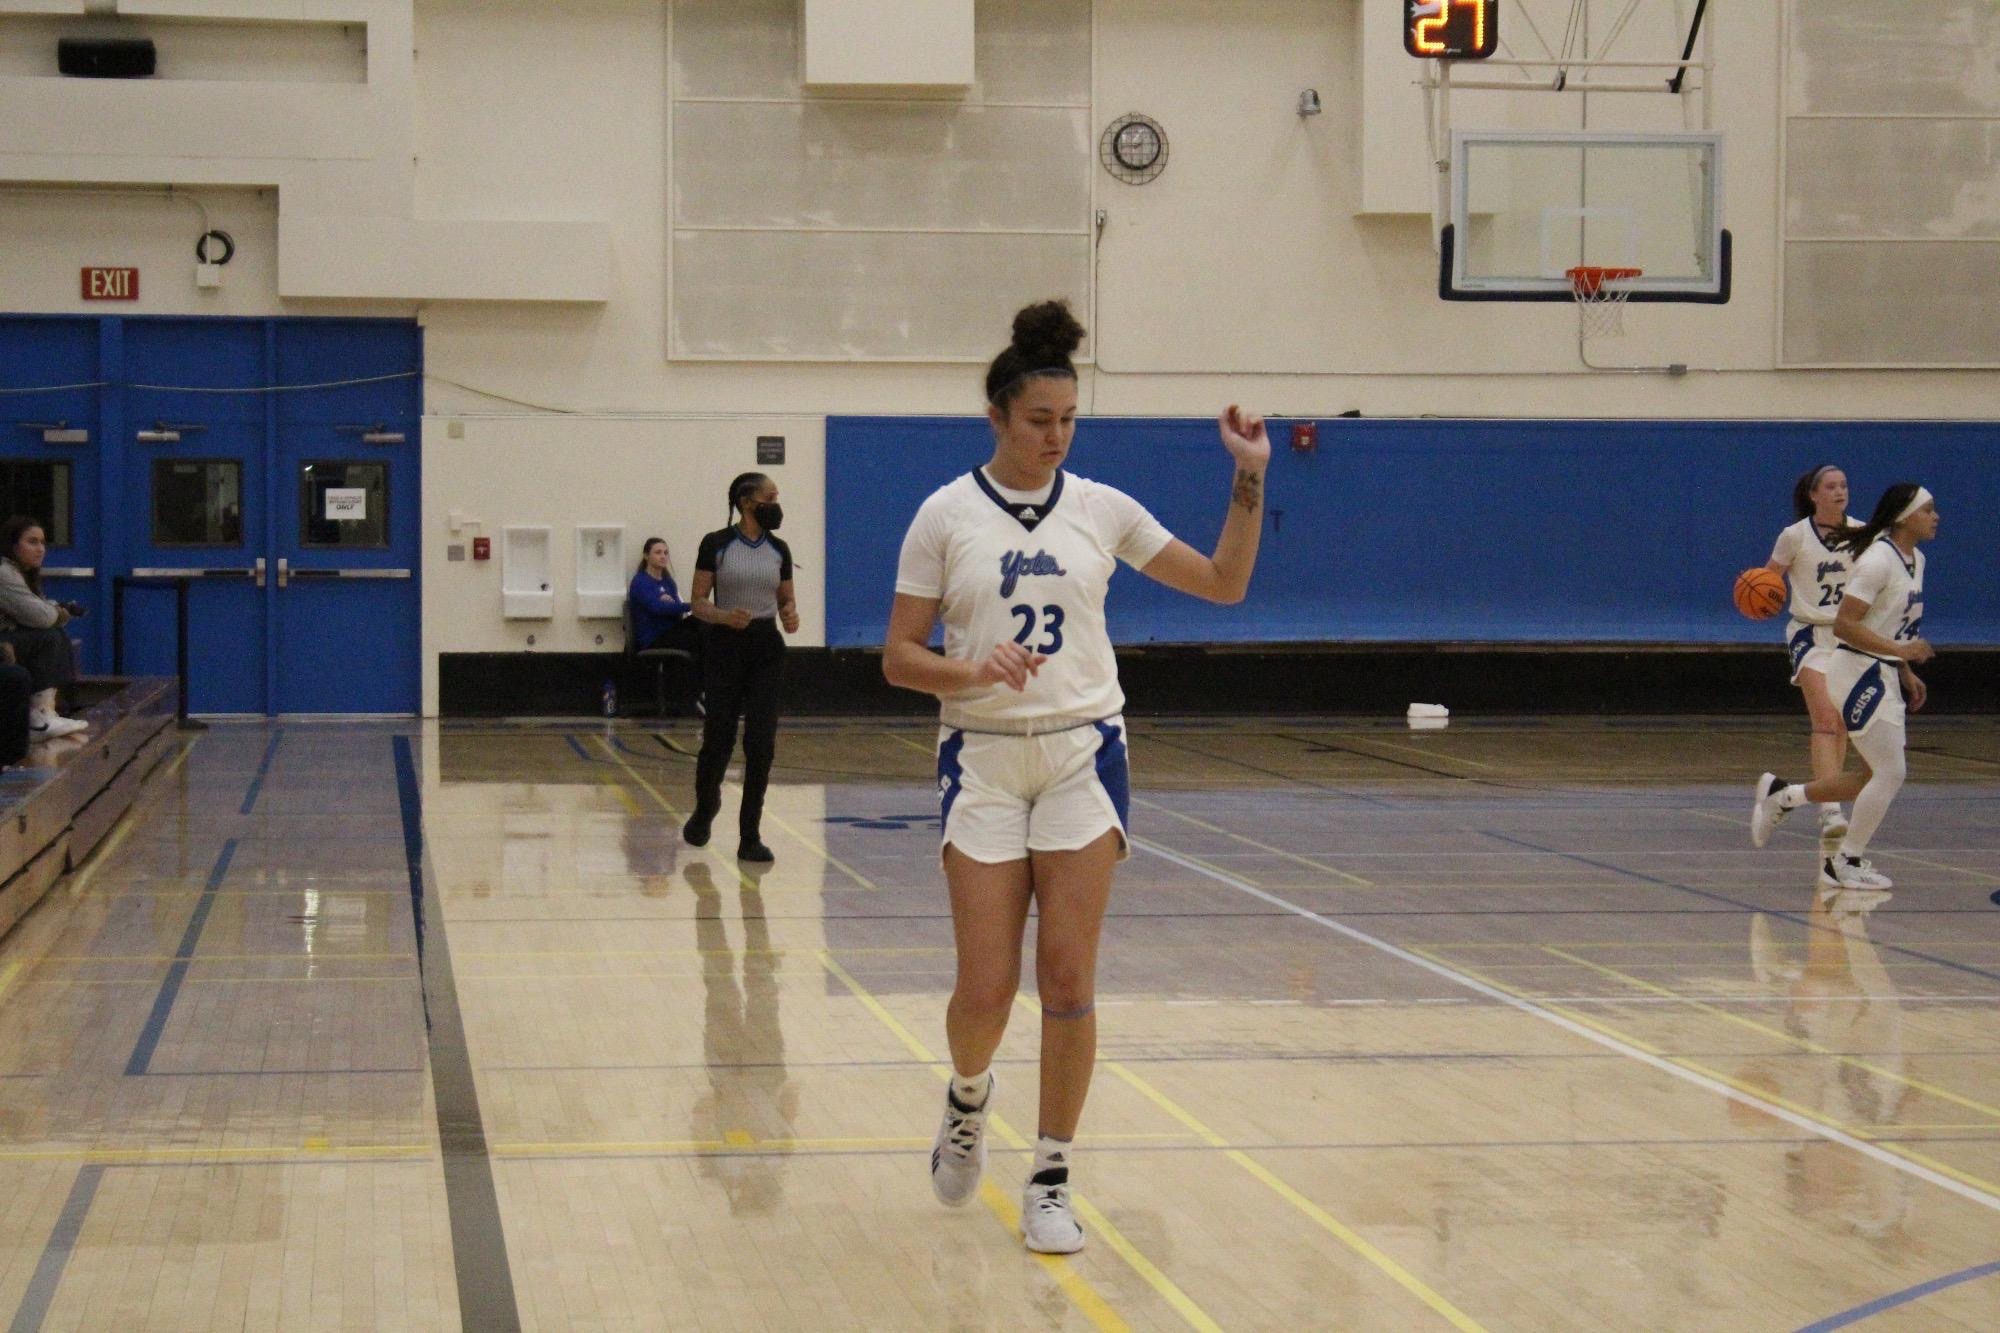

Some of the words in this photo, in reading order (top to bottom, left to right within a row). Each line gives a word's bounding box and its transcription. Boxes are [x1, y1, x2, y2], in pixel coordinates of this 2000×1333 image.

[1417, 0, 1484, 50] 27
[91, 269, 131, 297] EXIT
[1818, 583, 1846, 606] 25
[1010, 603, 1066, 655] 23
[1850, 686, 1878, 724] CSUSB
